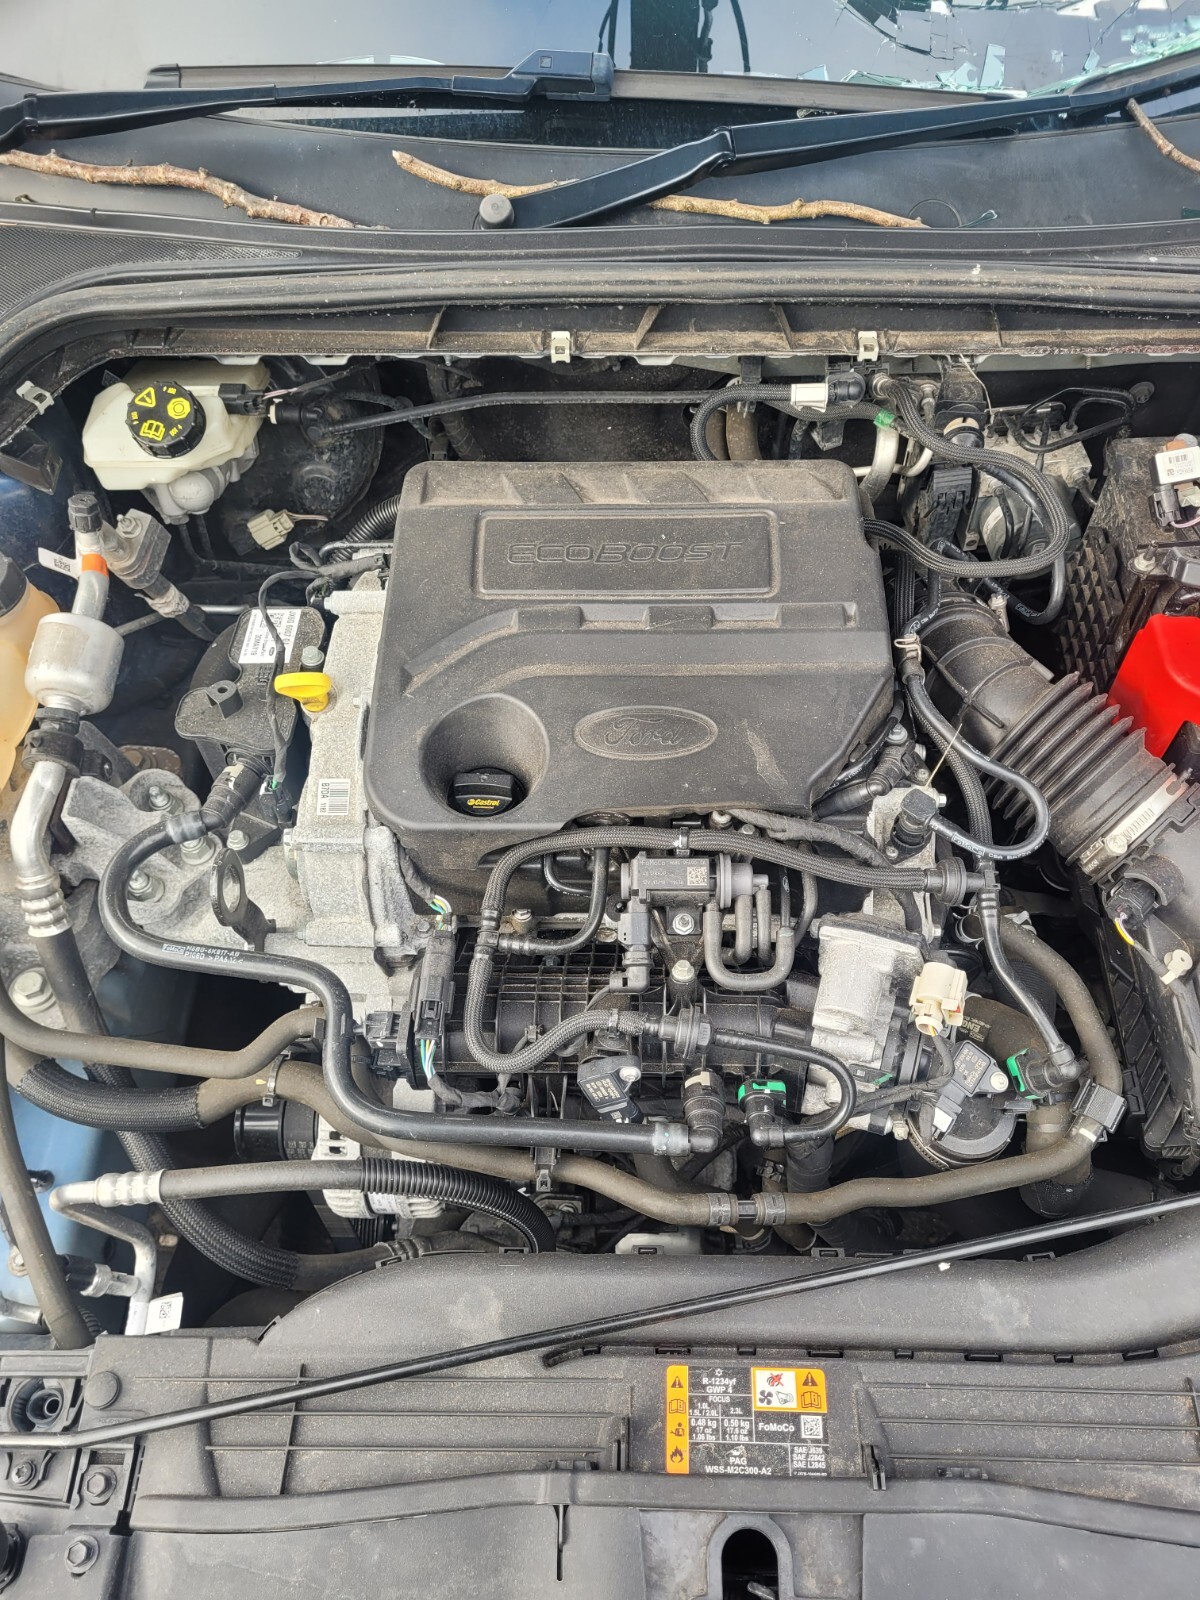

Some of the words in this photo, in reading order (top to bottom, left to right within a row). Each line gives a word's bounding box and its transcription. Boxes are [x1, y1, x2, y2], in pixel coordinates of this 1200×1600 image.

[507, 543, 743, 564] ECOBOOST
[604, 717, 684, 746] Ford
[475, 798, 500, 806] Castrol
[702, 1377, 737, 1386] R-1234yf
[706, 1385, 726, 1394] GWP
[727, 1386, 733, 1394] 4
[697, 1402, 711, 1410] 1.0L
[730, 1407, 743, 1415] 2.3L
[691, 1418, 706, 1427] 0.48
[707, 1418, 717, 1429] kg
[723, 1419, 739, 1428] 0.50
[740, 1419, 750, 1430] kg
[758, 1422, 795, 1432] FoMoCo
[695, 1426, 704, 1434] 17
[706, 1433, 716, 1441] lbs
[739, 1434, 749, 1442] lbs
[793, 1446, 808, 1454] SAE
[729, 1456, 748, 1466] PAG
[792, 1453, 807, 1461] SAE
[807, 1454, 826, 1462] J2842
[792, 1460, 807, 1469] SAE
[705, 1465, 772, 1475] WSS-M2C300-A2
